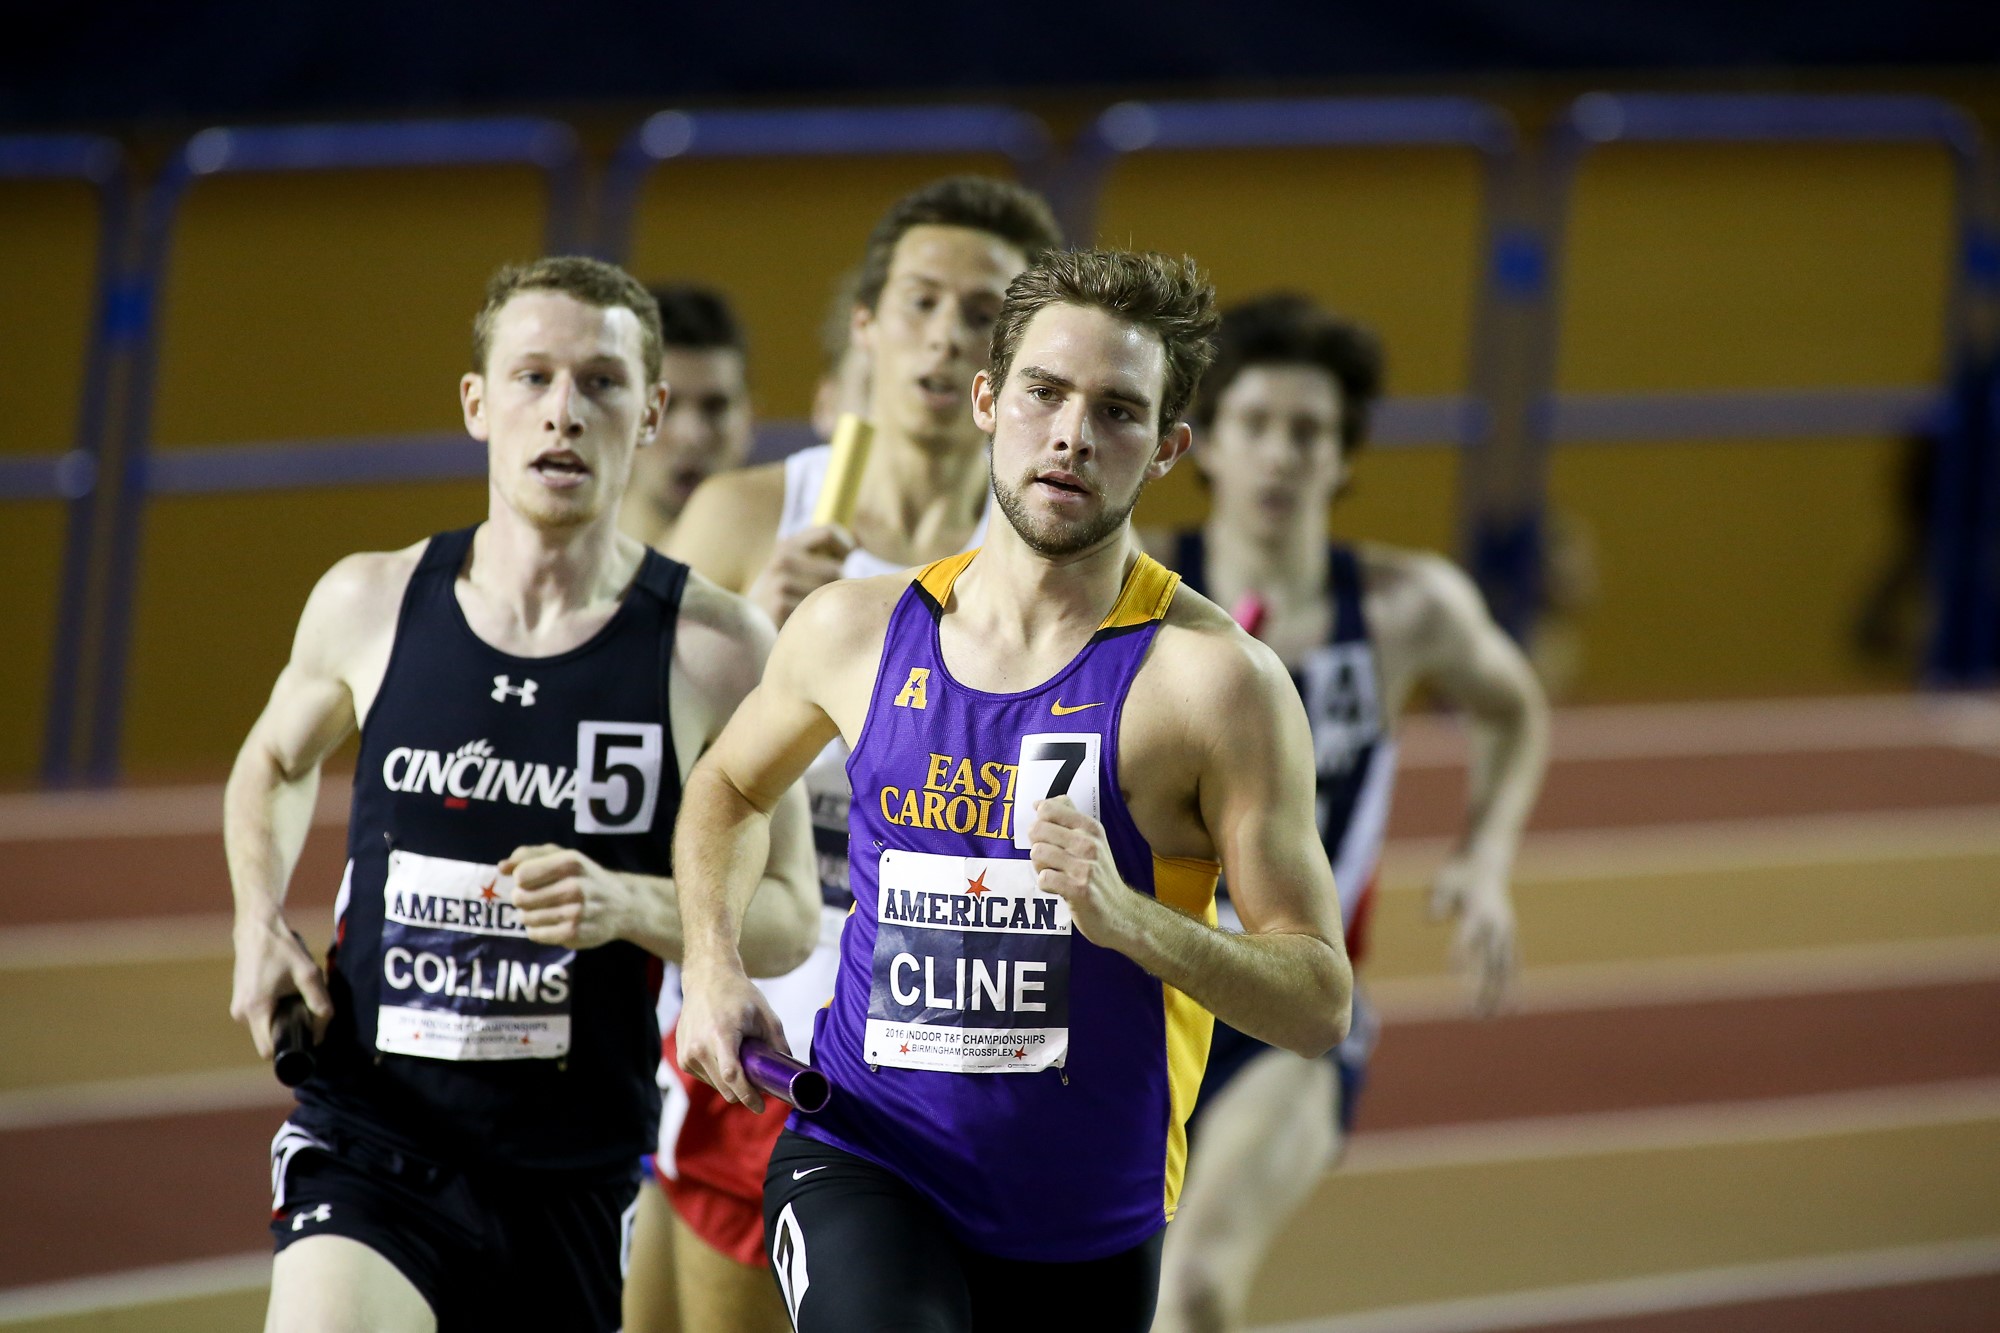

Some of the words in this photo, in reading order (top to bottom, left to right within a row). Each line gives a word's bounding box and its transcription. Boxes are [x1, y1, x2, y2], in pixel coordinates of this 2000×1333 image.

[589, 733, 645, 828] 5
[923, 753, 1019, 800] EAST
[1029, 742, 1087, 800] 7
[880, 786, 1015, 840] CAROLI
[394, 890, 527, 932] AMERIC
[884, 888, 1058, 931] AMERICAN
[383, 946, 570, 1003] COLLINS
[889, 952, 1047, 1012] CLINE
[885, 1028, 904, 1039] 2016
[906, 1030, 942, 1042] INDOOR
[944, 1033, 961, 1044] T&F
[963, 1034, 1046, 1045] CHAMPIONSHIPS
[911, 1044, 961, 1056] BIRMINGHAM
[963, 1048, 1014, 1057] CROSSPLEX
